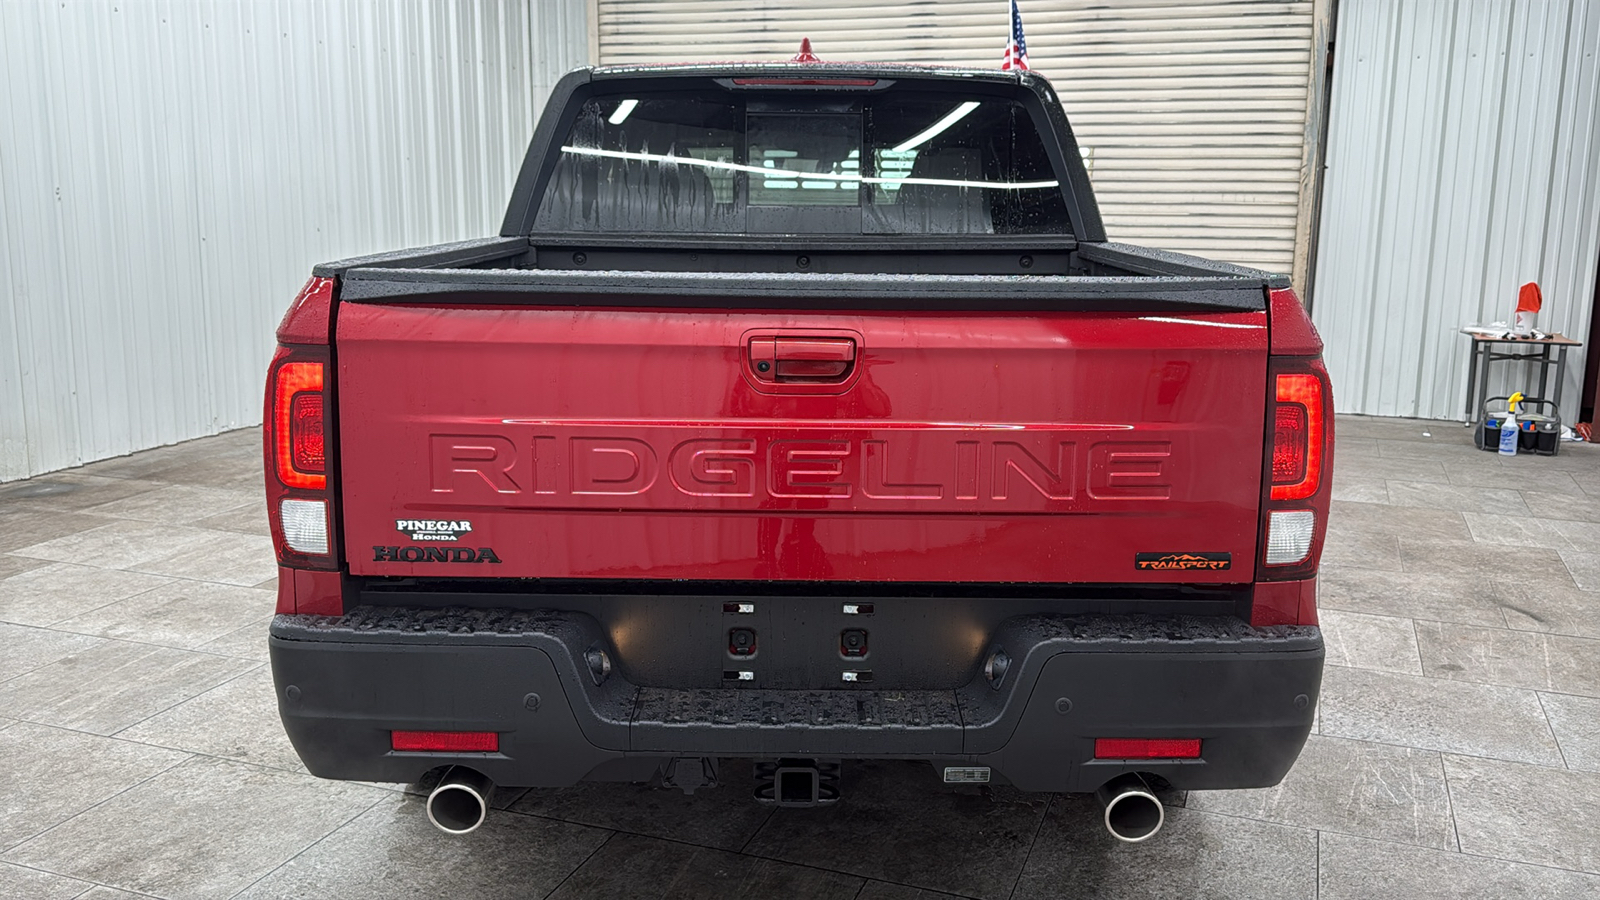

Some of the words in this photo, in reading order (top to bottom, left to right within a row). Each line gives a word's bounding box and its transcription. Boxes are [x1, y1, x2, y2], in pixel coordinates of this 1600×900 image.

[429, 433, 1172, 500] RIDGELINE
[396, 520, 472, 531] PINEGAR
[372, 545, 502, 563] HONDA
[1138, 560, 1229, 570] TRAILSPORT
